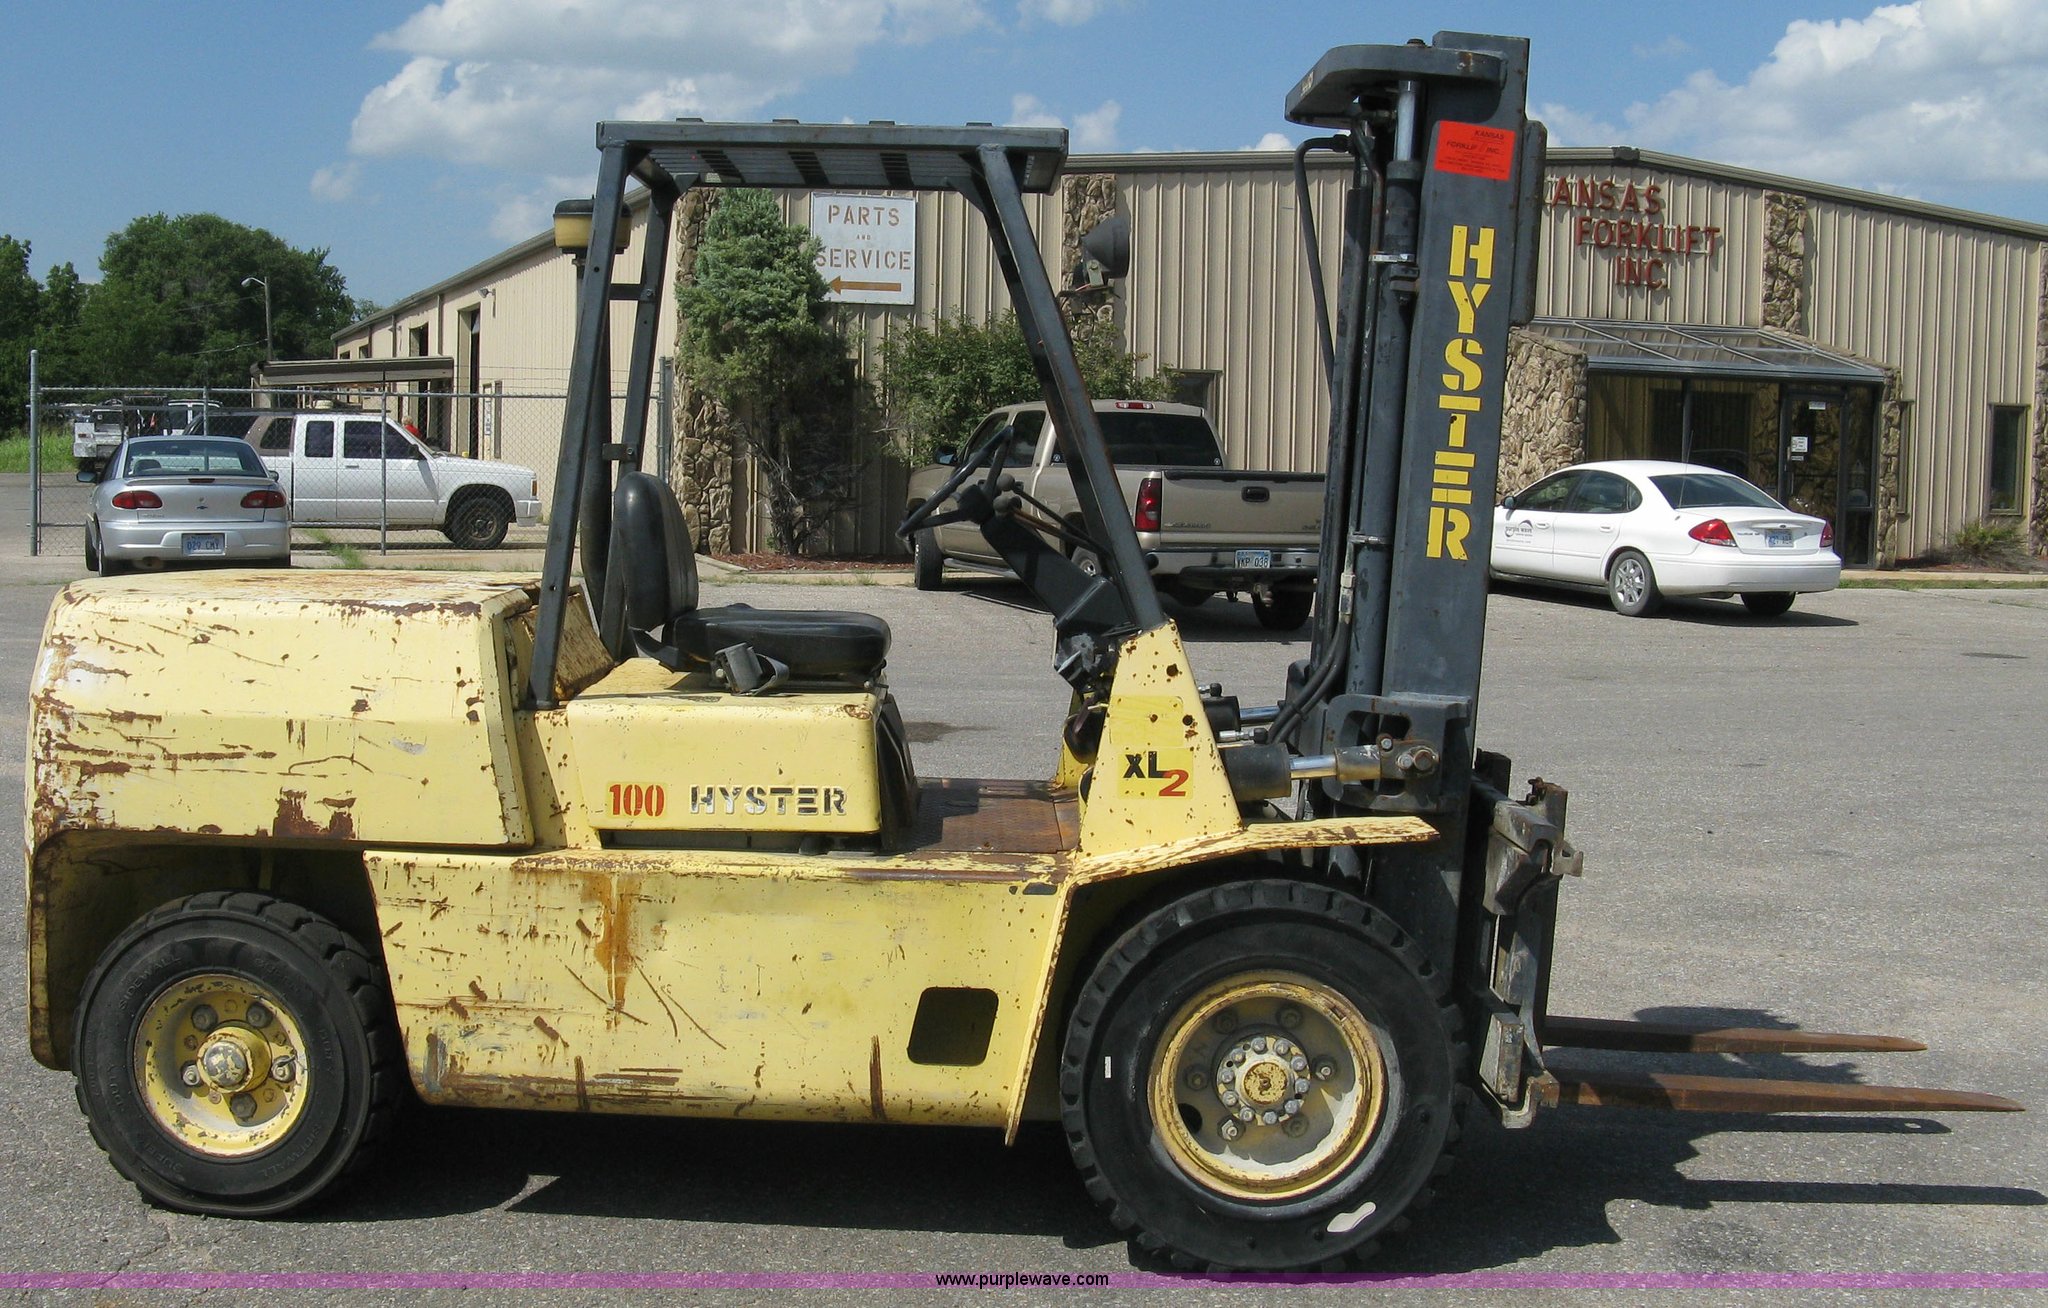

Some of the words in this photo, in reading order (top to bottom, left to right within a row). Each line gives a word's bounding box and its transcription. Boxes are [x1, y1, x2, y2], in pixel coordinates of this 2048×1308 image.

[1551, 175, 1662, 215] ANSAS
[827, 204, 900, 227] PARTS
[1576, 216, 1720, 256] FORKLIFT
[1426, 224, 1495, 561] HYSTER
[609, 783, 665, 817] 100
[689, 784, 848, 816] HYSTER
